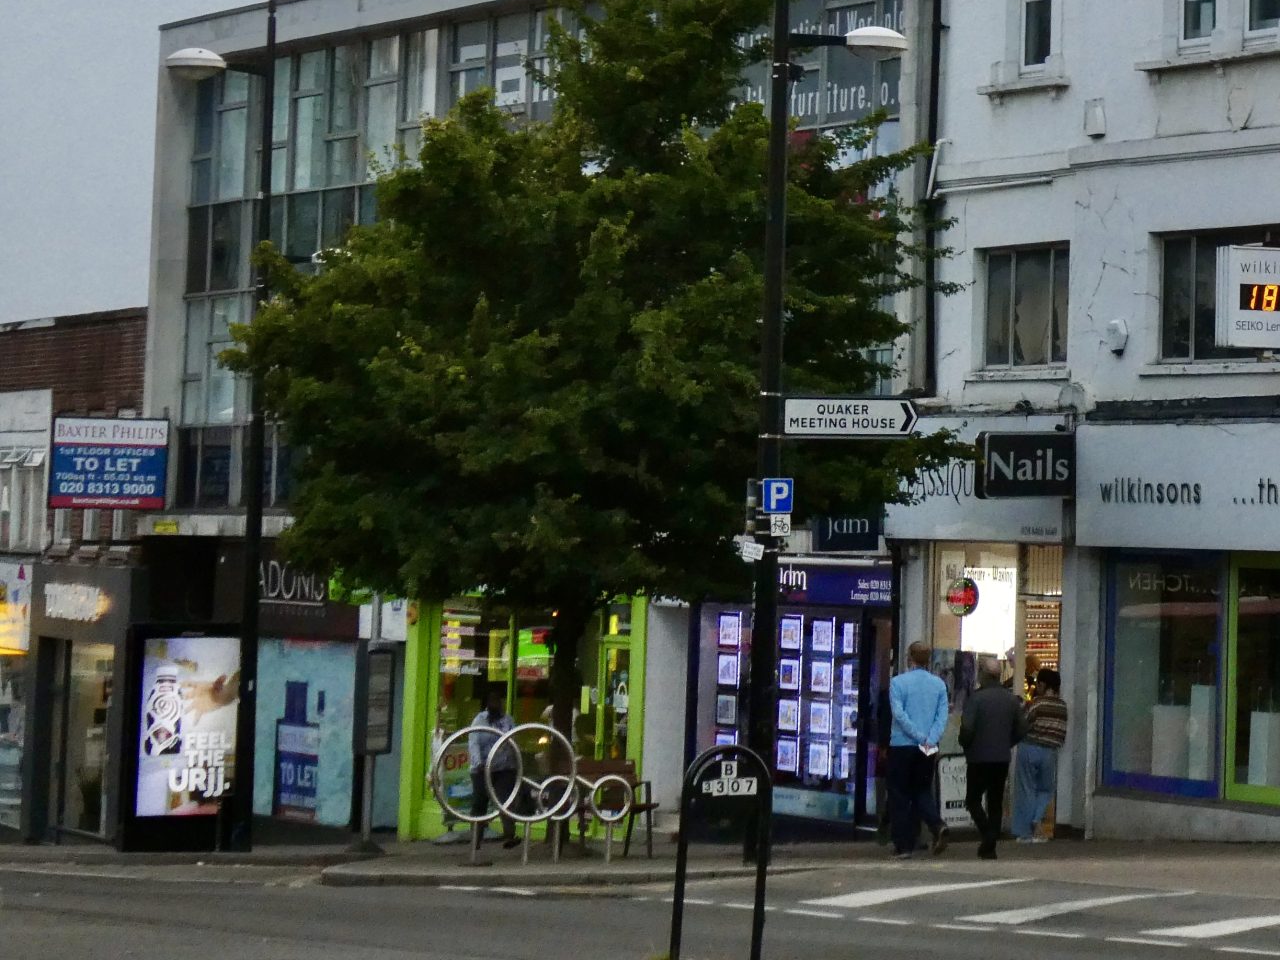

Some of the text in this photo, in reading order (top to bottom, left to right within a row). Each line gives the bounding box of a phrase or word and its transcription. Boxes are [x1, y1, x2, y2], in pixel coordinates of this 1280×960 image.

[1235, 321, 1264, 331] SEIKO
[816, 404, 869, 415] QUAKER
[789, 418, 896, 429] MEETING HOUSE
[58, 424, 164, 439] BAXTER PHILIPS
[77, 448, 111, 456] FLOOR
[113, 448, 156, 456] OFFICES
[73, 457, 142, 472] TO LET
[990, 448, 1070, 481] Nails
[60, 482, 155, 495] 020 8313 9000
[770, 482, 789, 510] P
[1099, 477, 1202, 504] wilkinsons
[185, 732, 231, 750] FEEL
[185, 750, 225, 767] THE
[280, 762, 317, 788] TO LET
[723, 764, 734, 776] B
